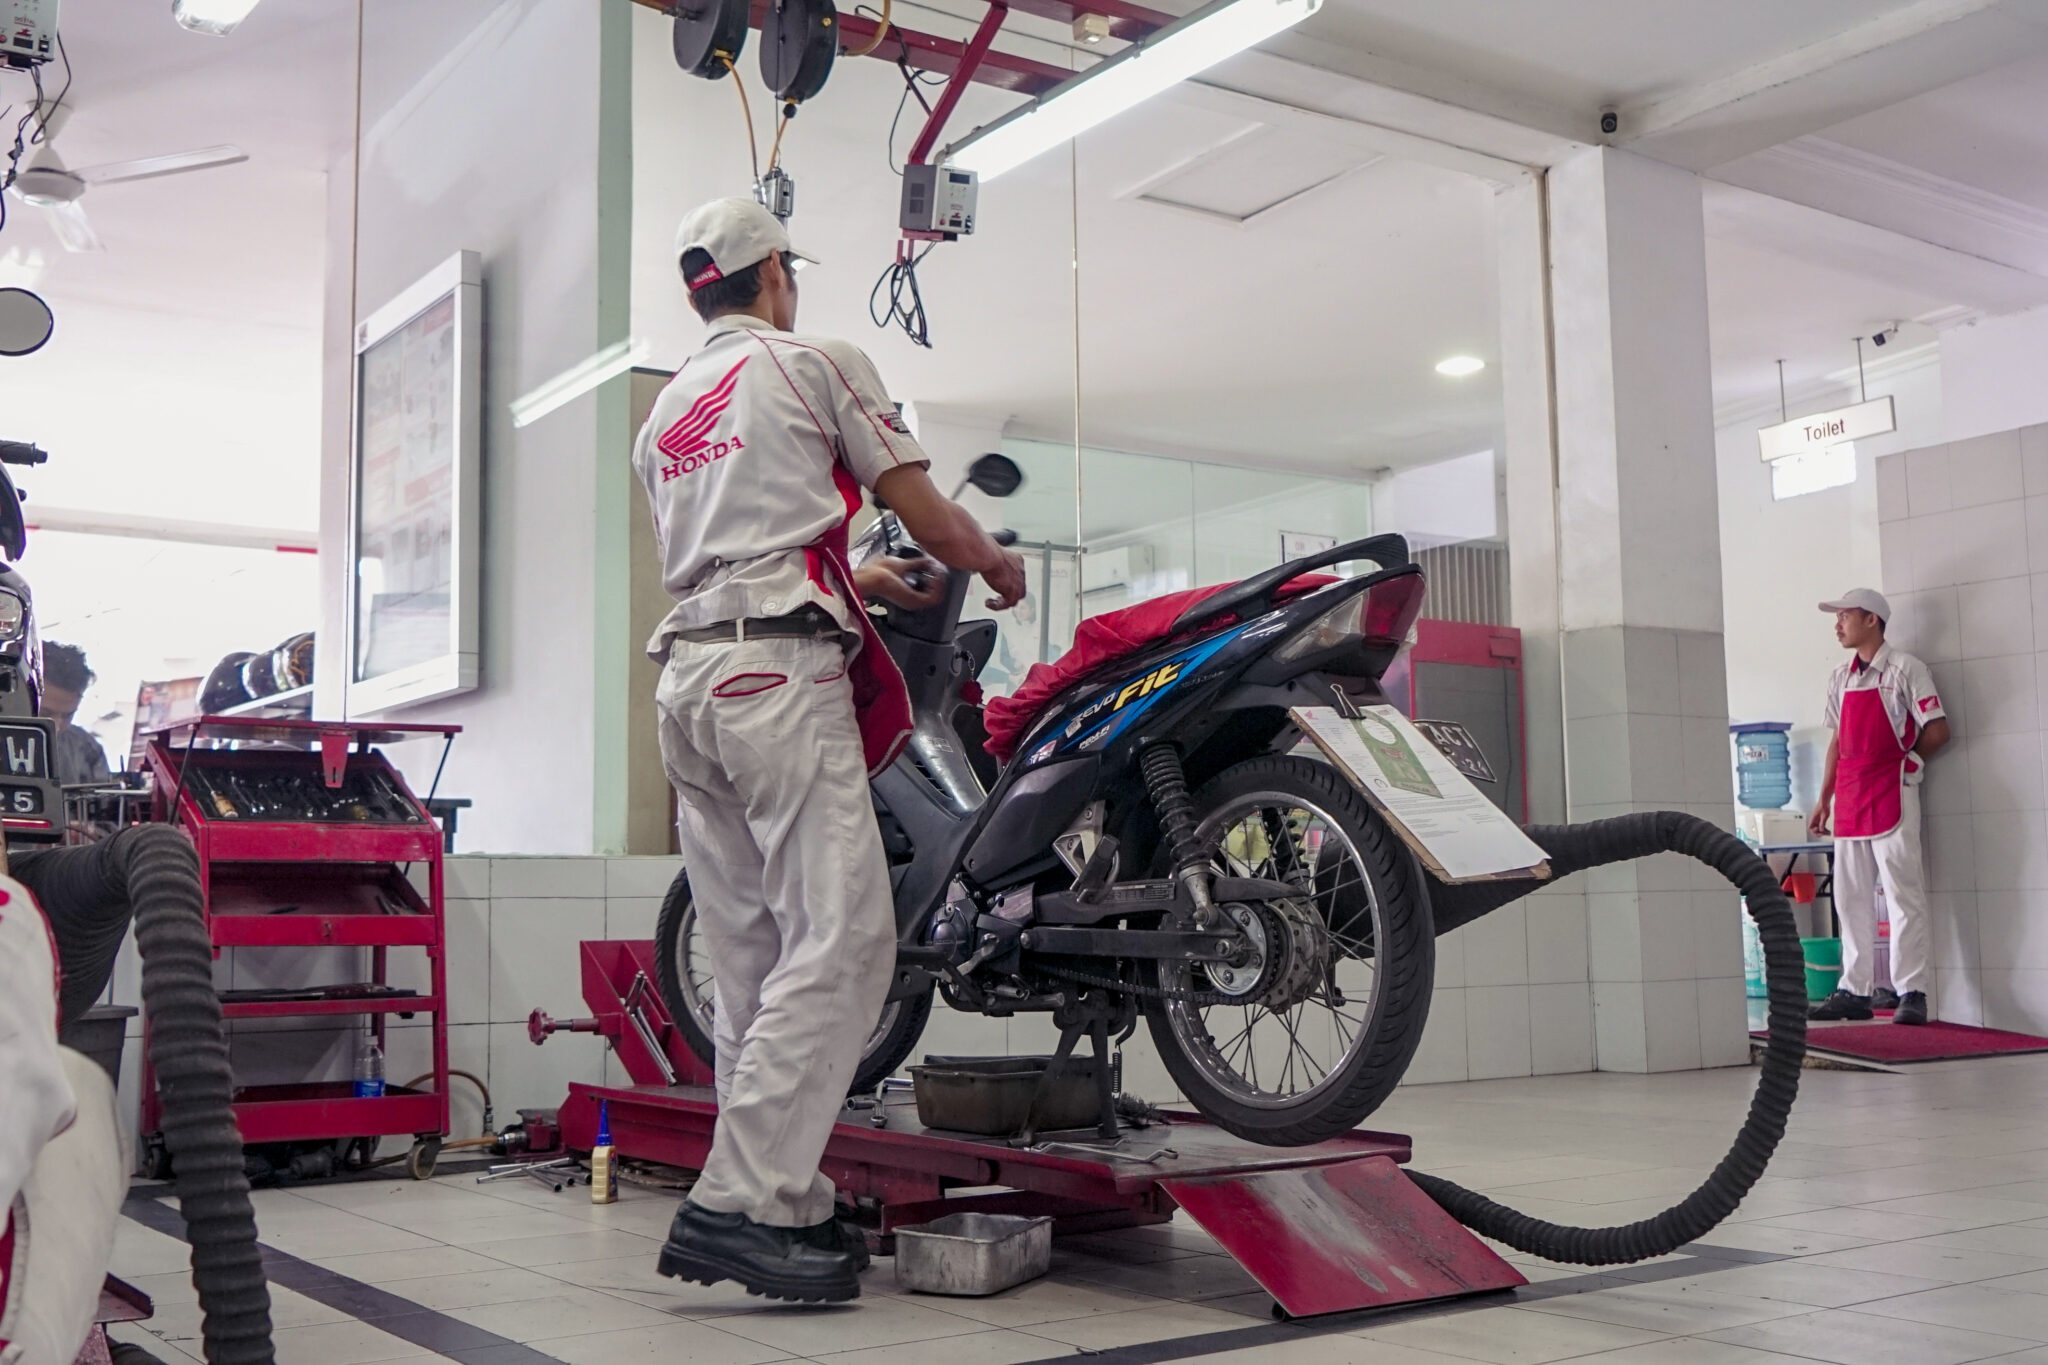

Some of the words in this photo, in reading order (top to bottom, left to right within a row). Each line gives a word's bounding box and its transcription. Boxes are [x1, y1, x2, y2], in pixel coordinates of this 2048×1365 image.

[692, 269, 717, 283] HONDA
[1803, 418, 1845, 442] Toilet
[661, 436, 746, 482] HONDA
